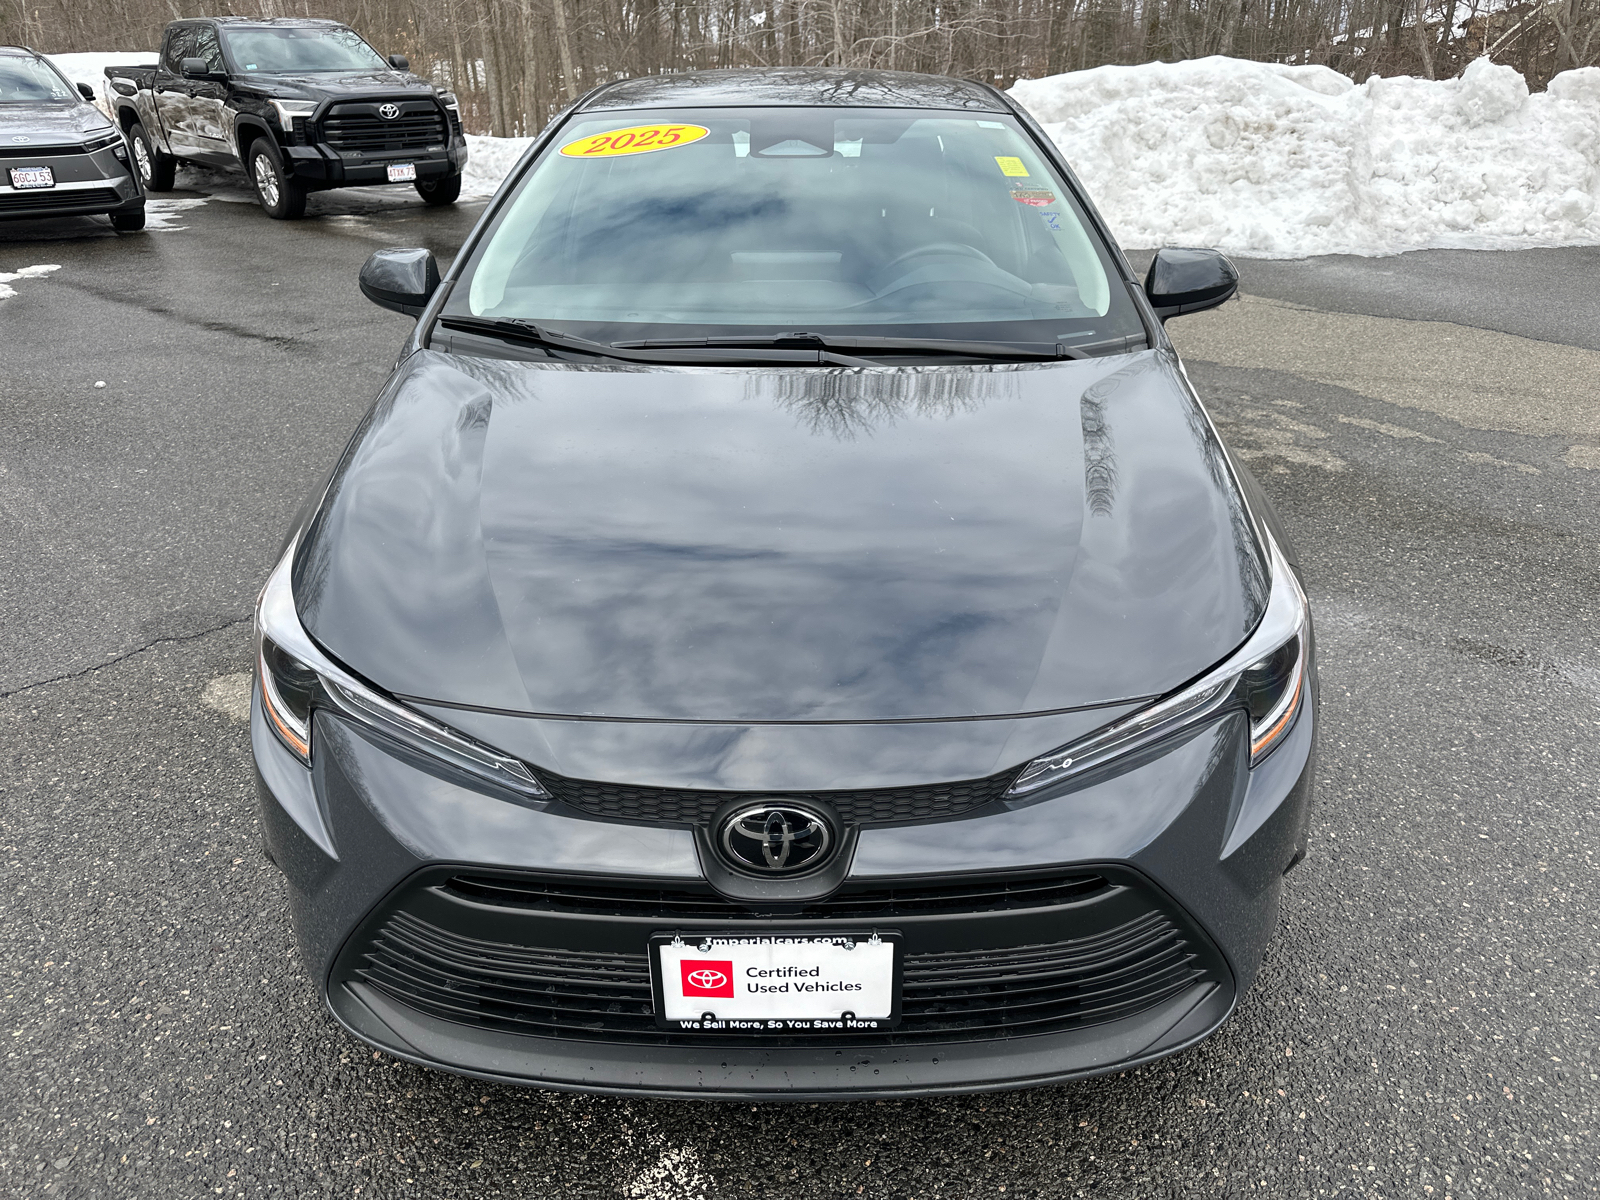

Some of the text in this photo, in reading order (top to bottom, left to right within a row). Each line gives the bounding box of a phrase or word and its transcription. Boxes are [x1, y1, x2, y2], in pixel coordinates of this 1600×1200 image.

[583, 127, 686, 155] 2025
[13, 171, 52, 183] 6GCJ 53
[406, 166, 415, 176] 73
[705, 936, 848, 947] Imperialcars.com
[746, 966, 820, 978] Certified
[747, 981, 862, 993] Used Vehicles
[680, 1020, 878, 1030] We Sell More, So You Save More
